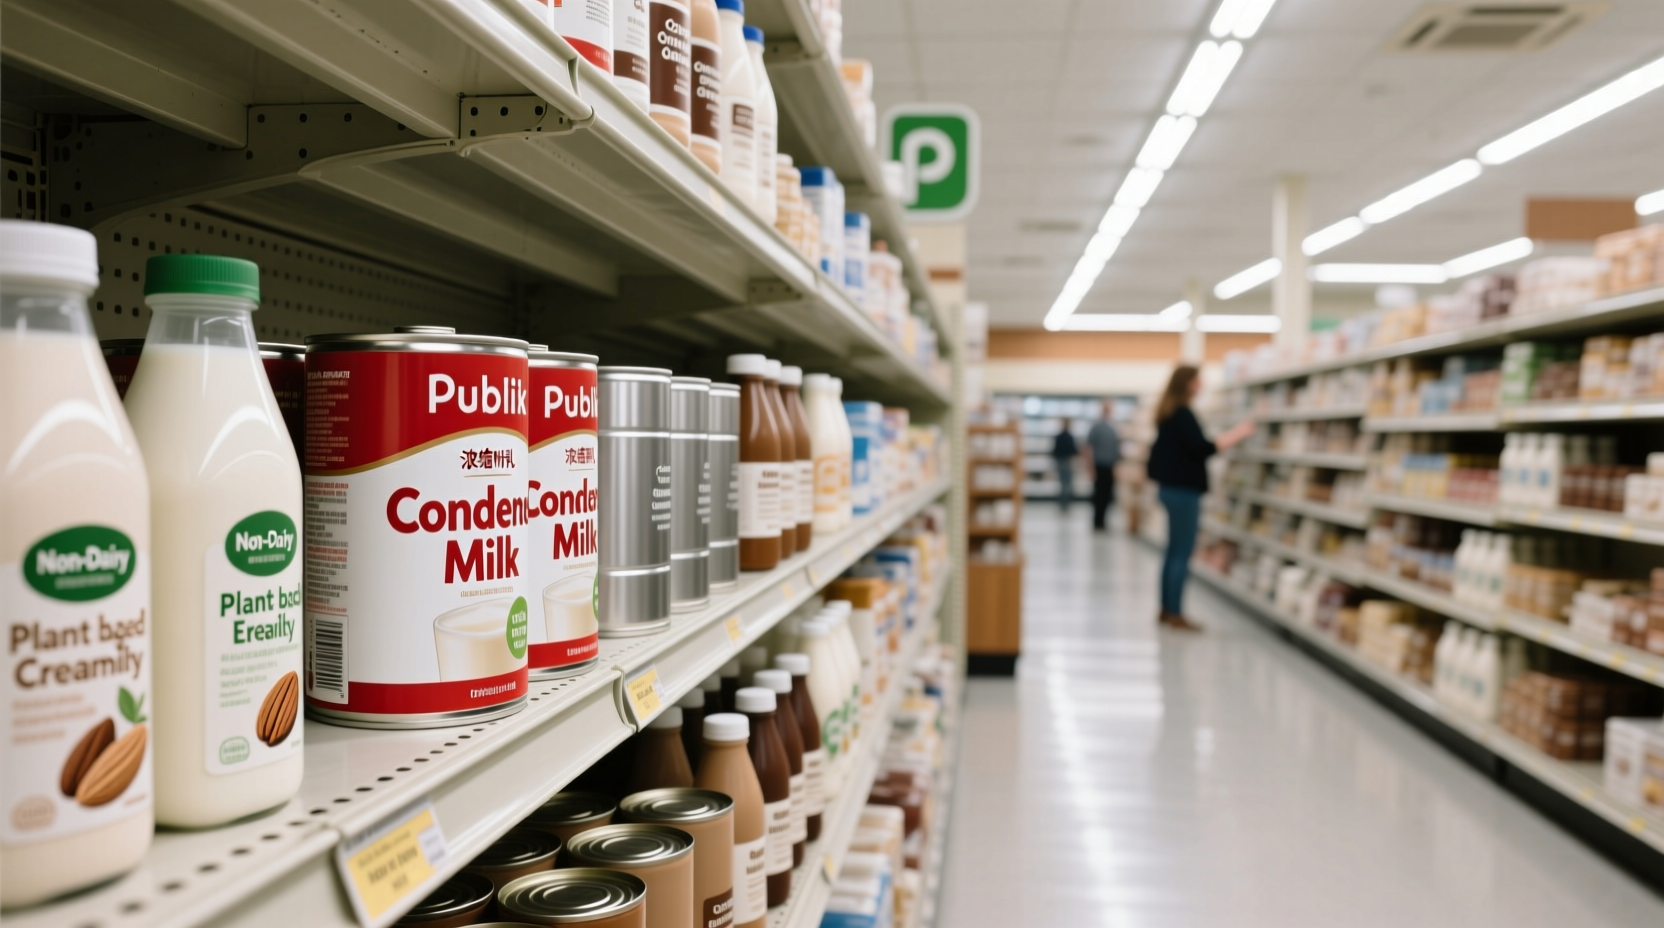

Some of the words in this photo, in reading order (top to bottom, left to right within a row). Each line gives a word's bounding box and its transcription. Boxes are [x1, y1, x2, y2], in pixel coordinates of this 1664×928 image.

[428, 373, 527, 415] Publik
[444, 535, 520, 584] Milk
[553, 518, 598, 560] Milk
[220, 589, 275, 617] Plant
[9, 619, 90, 656] Plant
